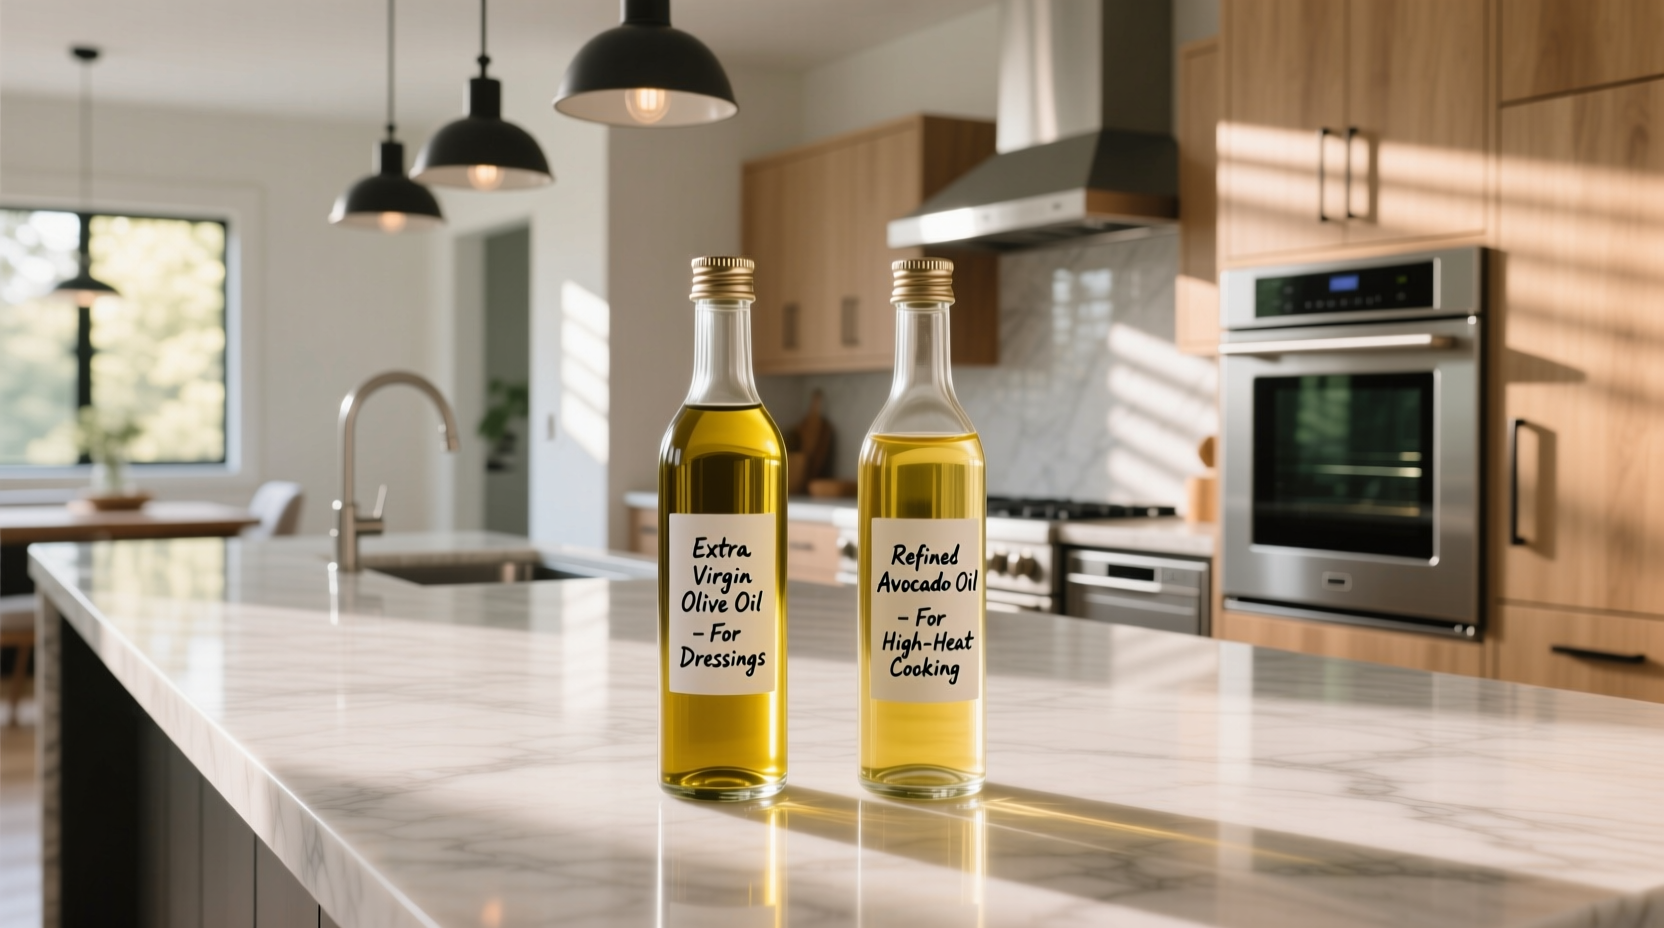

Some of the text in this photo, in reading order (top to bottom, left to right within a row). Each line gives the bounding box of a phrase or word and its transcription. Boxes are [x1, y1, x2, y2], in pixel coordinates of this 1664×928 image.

[692, 535, 752, 559] Extra
[890, 543, 961, 572] Refined
[693, 564, 753, 595] Virgin
[876, 569, 979, 594] Avocado Oil
[681, 590, 764, 613] Olive Oil
[915, 606, 947, 627] For
[709, 622, 742, 643] For
[881, 630, 975, 660] High-Heat
[679, 645, 767, 678] Dressings
[889, 656, 961, 686] Cooking
